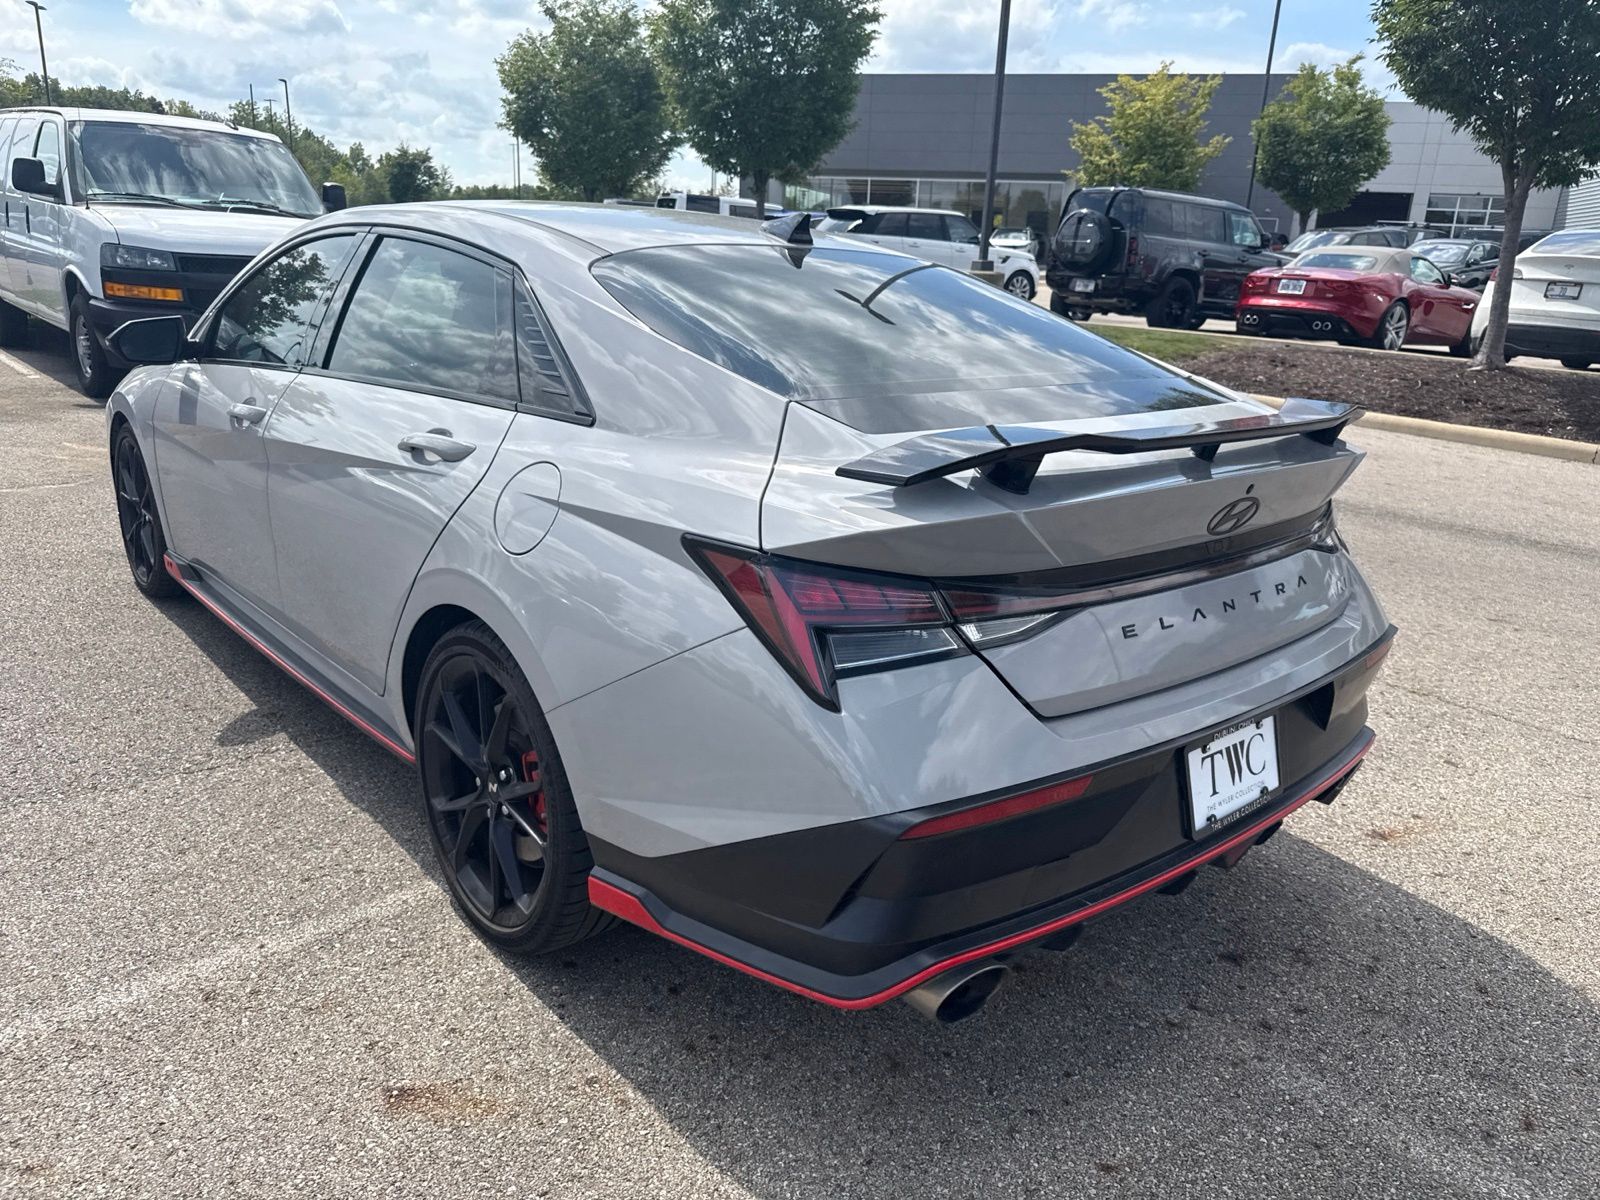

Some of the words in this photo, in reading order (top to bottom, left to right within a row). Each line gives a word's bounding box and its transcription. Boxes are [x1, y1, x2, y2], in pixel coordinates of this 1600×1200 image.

[1121, 575, 1307, 639] ELANTRA
[1201, 733, 1266, 797] TWC
[488, 782, 498, 793] N
[1207, 802, 1217, 812] THE
[1218, 794, 1234, 807] WYLER
[1235, 780, 1265, 799] COLLECTION
[1211, 820, 1222, 831] THE
[1222, 811, 1240, 826] WYLER
[1240, 794, 1271, 816] COLLECTION
